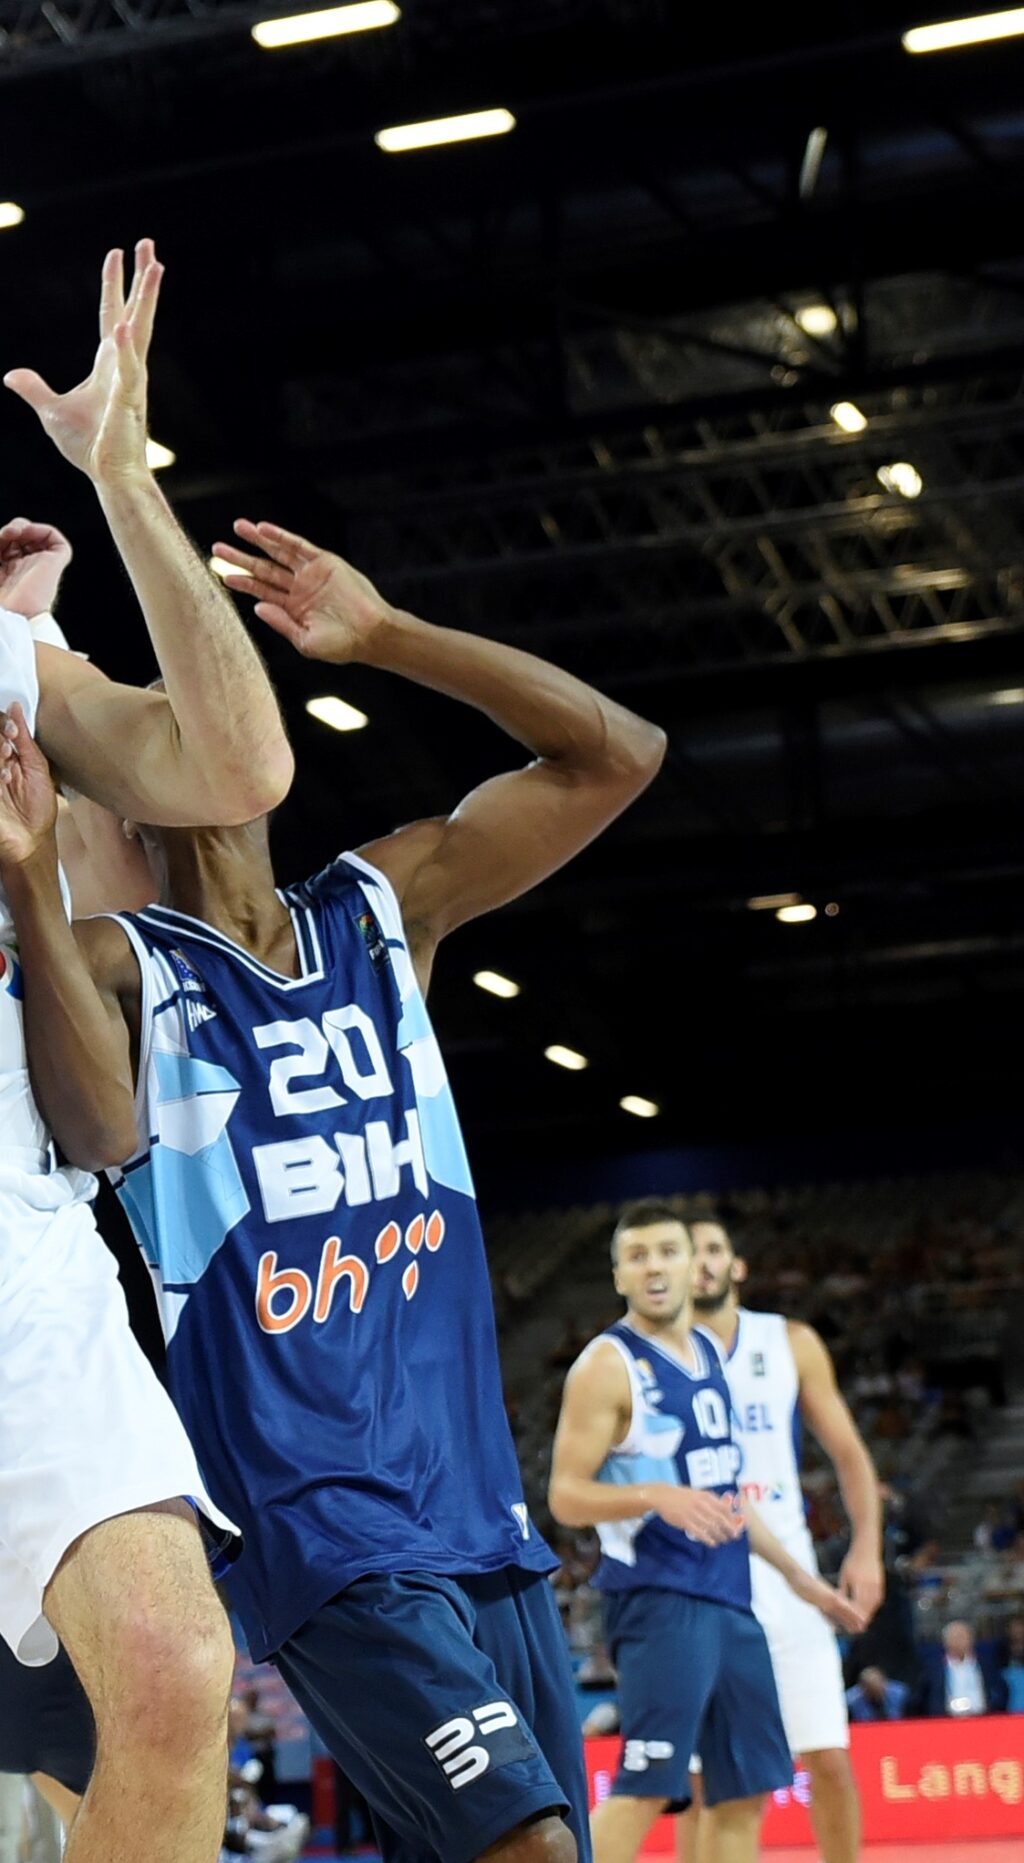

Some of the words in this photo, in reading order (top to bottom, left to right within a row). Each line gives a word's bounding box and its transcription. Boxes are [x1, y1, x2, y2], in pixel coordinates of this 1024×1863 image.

[252, 1003, 394, 1117] 20
[256, 1236, 369, 1334] bh
[692, 1387, 729, 1440] 10
[880, 1754, 1023, 1806] Lang
